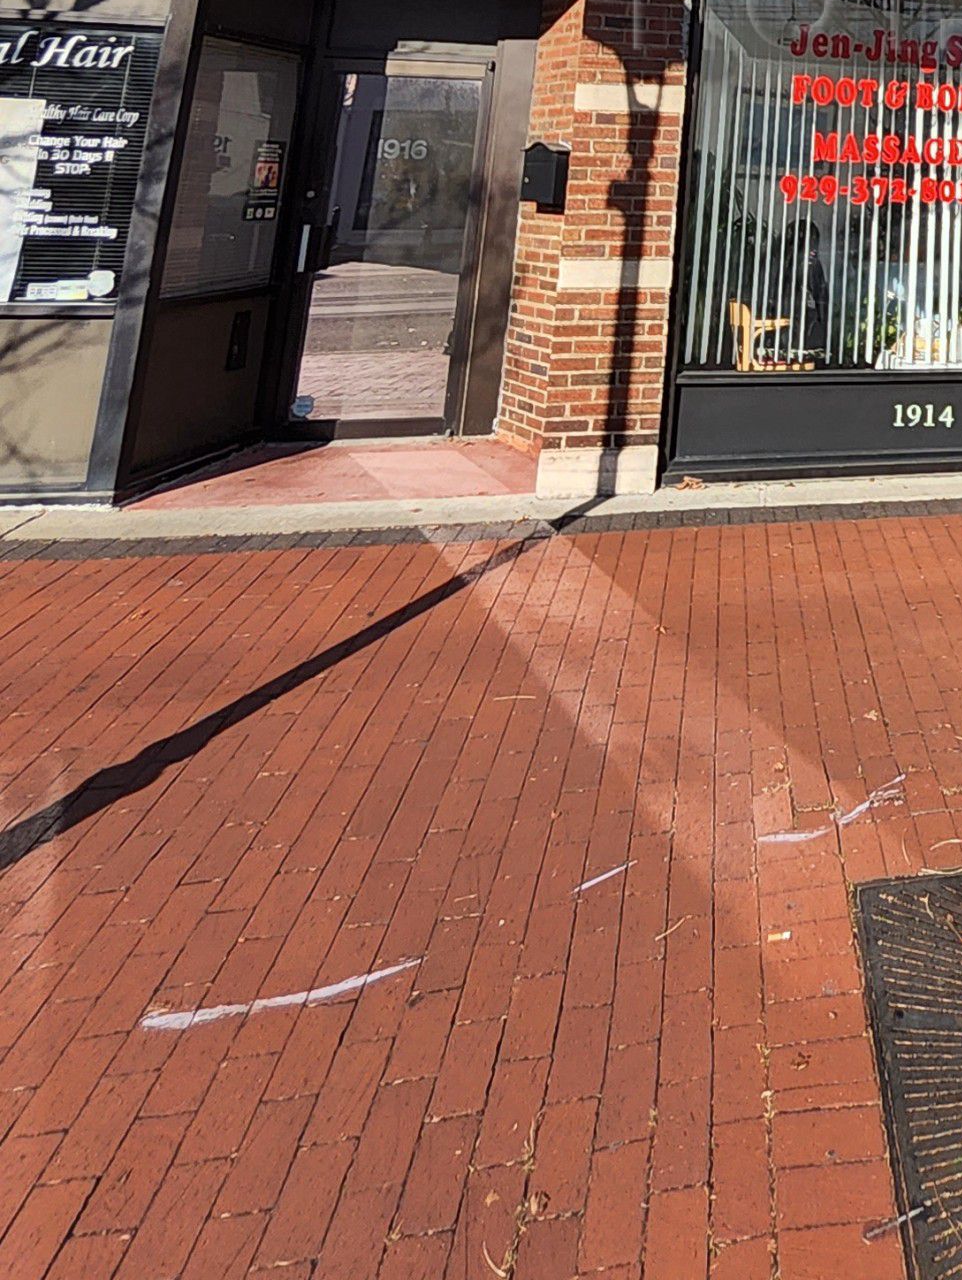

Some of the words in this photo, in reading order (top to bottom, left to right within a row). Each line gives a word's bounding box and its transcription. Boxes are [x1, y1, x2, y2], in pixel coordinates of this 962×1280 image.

[30, 35, 135, 68] Hair
[790, 24, 938, 73] Jen-Jing
[792, 74, 878, 108] FOOT
[885, 80, 909, 110] &
[92, 108, 116, 122] Care
[116, 108, 140, 127] Corp
[28, 134, 71, 148] Change
[72, 135, 101, 148] Your
[101, 136, 129, 149] Hair
[376, 138, 428, 160] 1916
[50, 148, 70, 161] 30
[72, 150, 102, 163] Days
[892, 404, 955, 428] 1914
